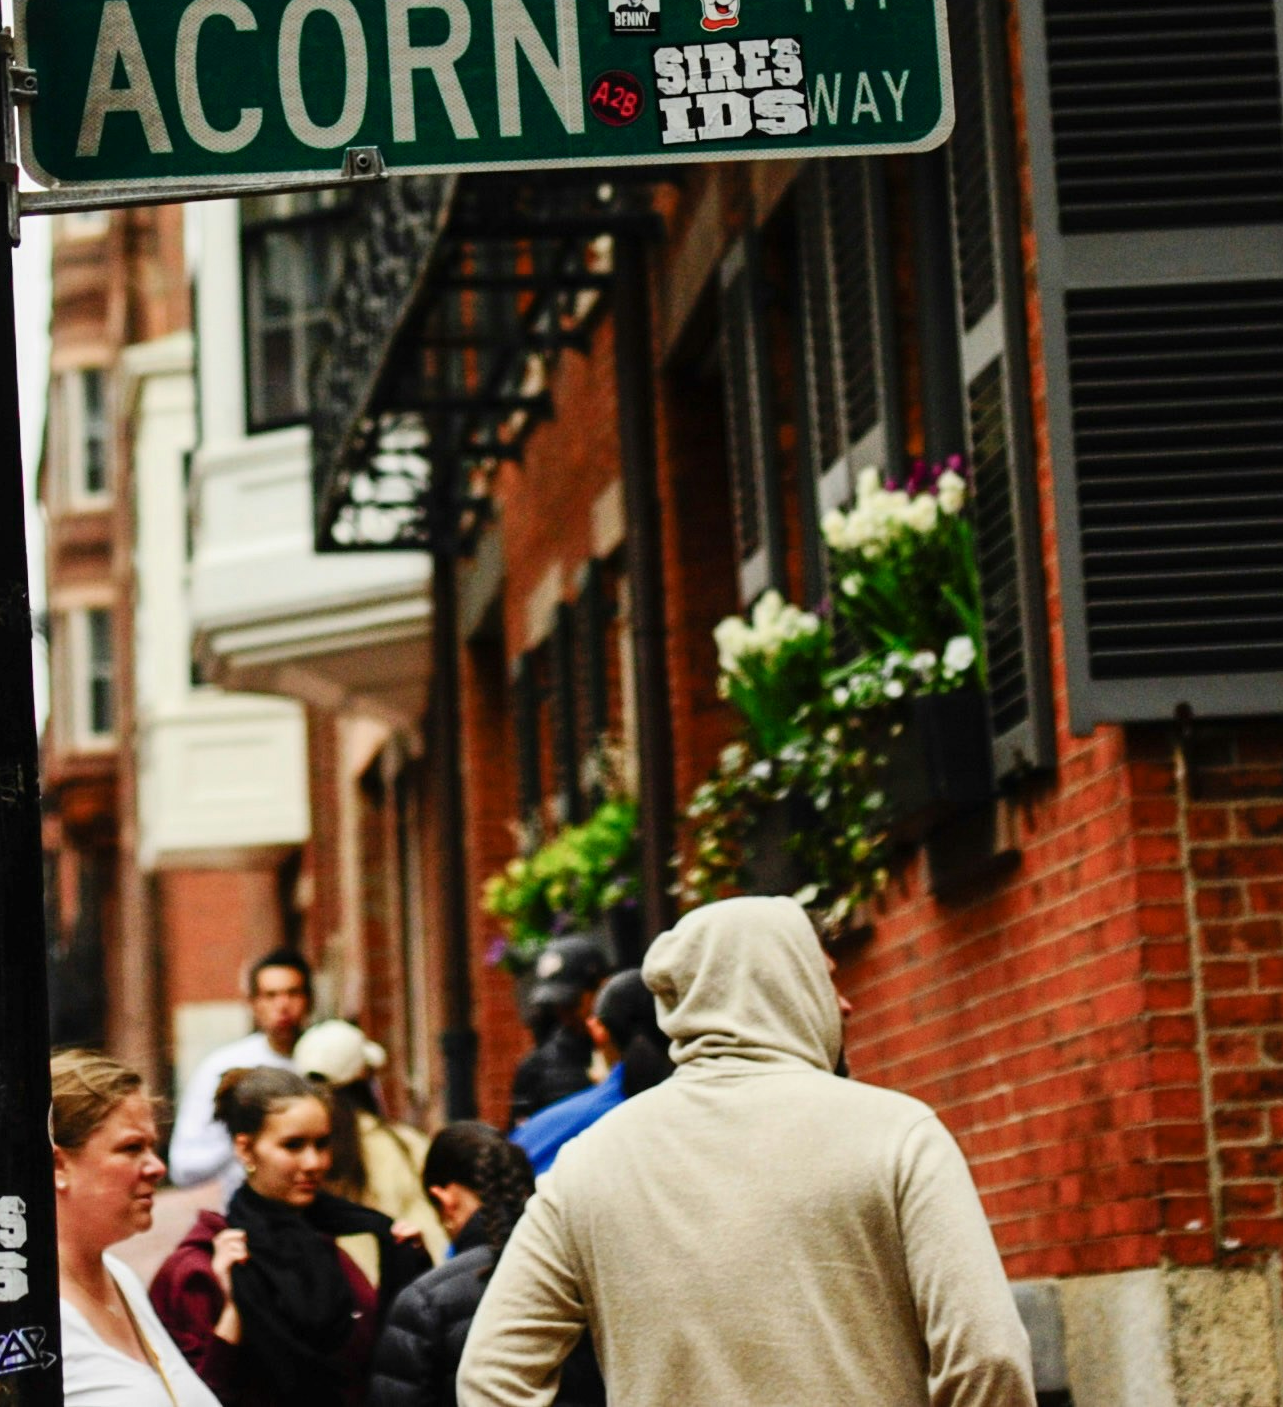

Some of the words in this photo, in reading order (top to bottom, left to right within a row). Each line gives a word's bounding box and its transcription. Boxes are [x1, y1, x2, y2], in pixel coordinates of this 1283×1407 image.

[614, 11, 651, 27] BENNY
[652, 37, 804, 95] SIRES
[591, 81, 638, 118] A2B
[658, 88, 808, 145] IDS
[806, 69, 911, 126] WAY
